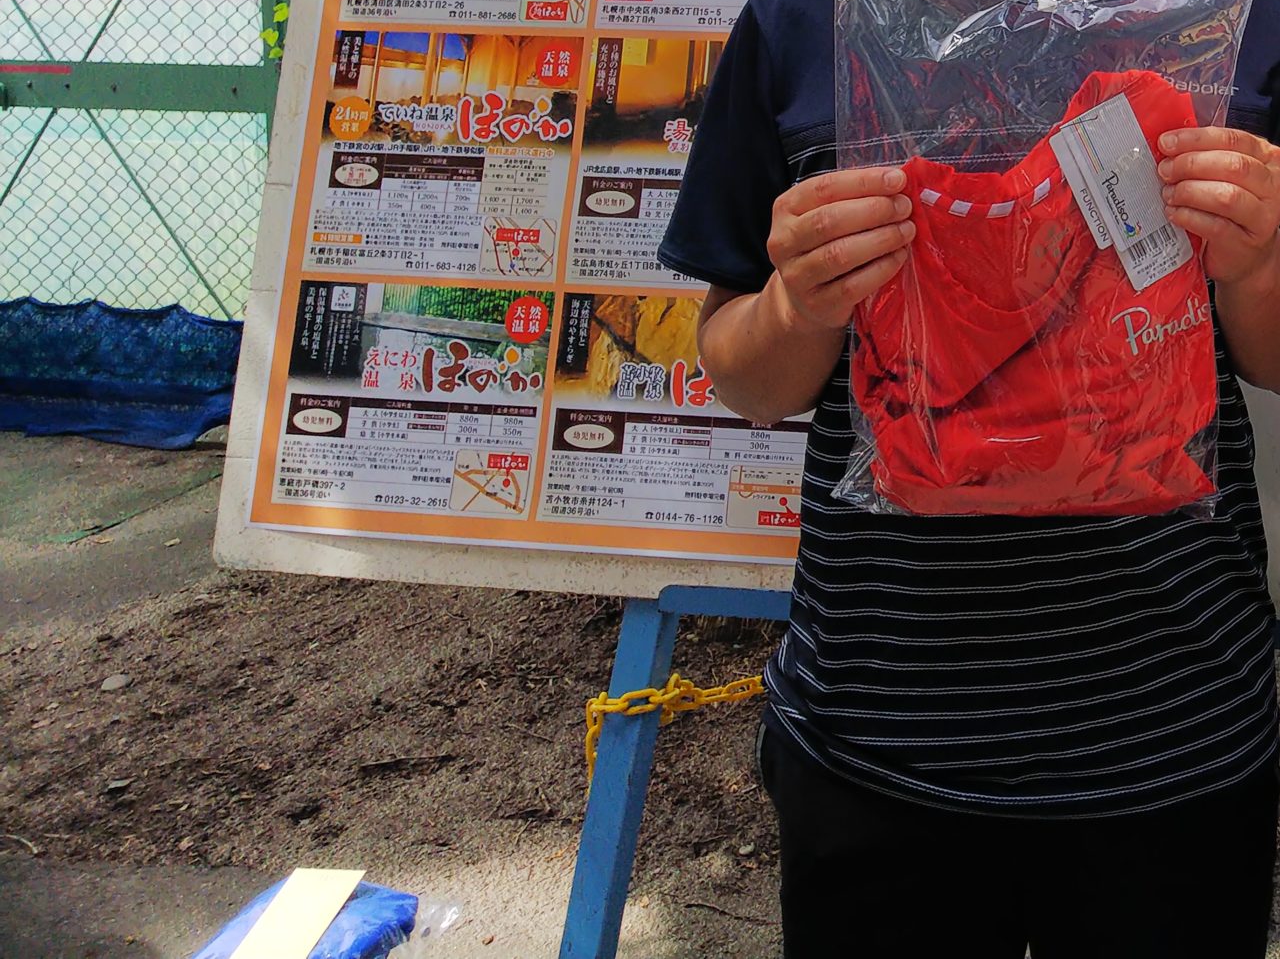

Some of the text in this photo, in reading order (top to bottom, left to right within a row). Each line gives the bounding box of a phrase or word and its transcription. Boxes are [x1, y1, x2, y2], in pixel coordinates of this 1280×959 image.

[458, 11, 517, 20] 011-881-2686
[602, 6, 722, 17] 札幌市中央区南3条西2丁目15-5
[543, 51, 571, 63] 天然
[541, 63, 570, 77] 温泉
[335, 106, 368, 120] 24時間
[379, 92, 573, 141] ていね温泉 ほのか
[592, 180, 633, 190] 料金のご案内
[595, 197, 626, 207] 幼児無料
[1101, 169, 1129, 225] Paradiso
[1079, 187, 1110, 243] FUNCTION
[415, 260, 477, 271] 011-683-4126
[513, 307, 542, 320] 天然
[512, 320, 540, 333] 温泉
[578, 299, 591, 347] 天然温泉と
[367, 349, 417, 368] えにわ
[421, 342, 542, 392] ほのか
[620, 363, 665, 382] 苫小牧
[300, 398, 340, 408] 料金のご案内
[302, 416, 333, 425] 幼児無料
[503, 418, 523, 426] 980円
[570, 413, 612, 423] 料金のご案内
[458, 425, 478, 434] 300円
[502, 428, 522, 436] 350円
[573, 431, 604, 441] 幼児無料
[750, 431, 771, 440] 880円
[750, 442, 770, 451] 300円
[384, 495, 448, 507] 0123-32-2615
[545, 494, 626, 508] 苫小牧市糸井124-1
[655, 511, 723, 524] 0144-76-1126
